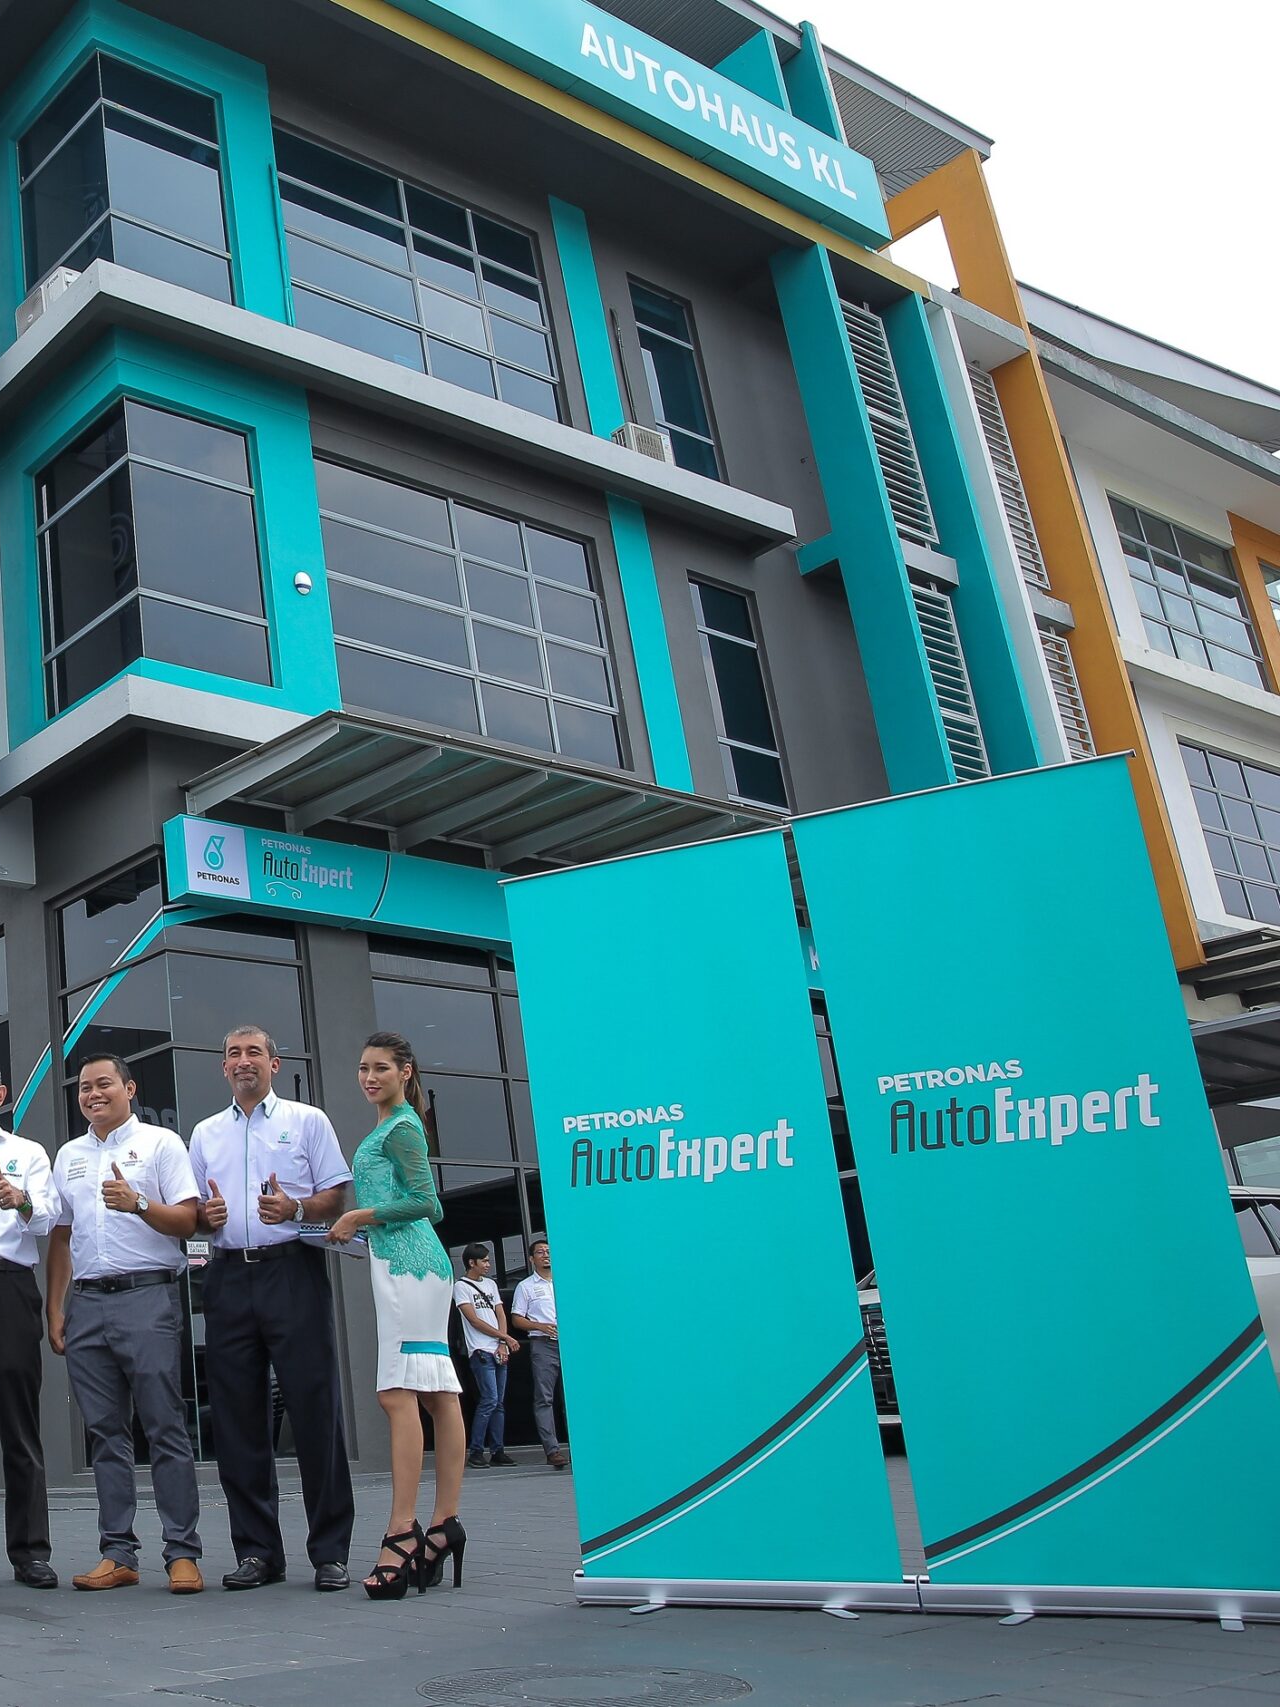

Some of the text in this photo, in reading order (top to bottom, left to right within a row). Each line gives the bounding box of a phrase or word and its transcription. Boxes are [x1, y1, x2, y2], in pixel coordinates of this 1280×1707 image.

[580, 22, 857, 201] AUTOHAUS KL
[261, 838, 312, 855] PETRONAS
[197, 871, 240, 887] PETRONAS
[263, 851, 353, 890] AutoExpert
[877, 1059, 1023, 1095] PETRONAS
[562, 1104, 684, 1134] PETRONAS
[888, 1073, 1160, 1154] AutoExpert
[570, 1118, 794, 1188] AutoExpert
